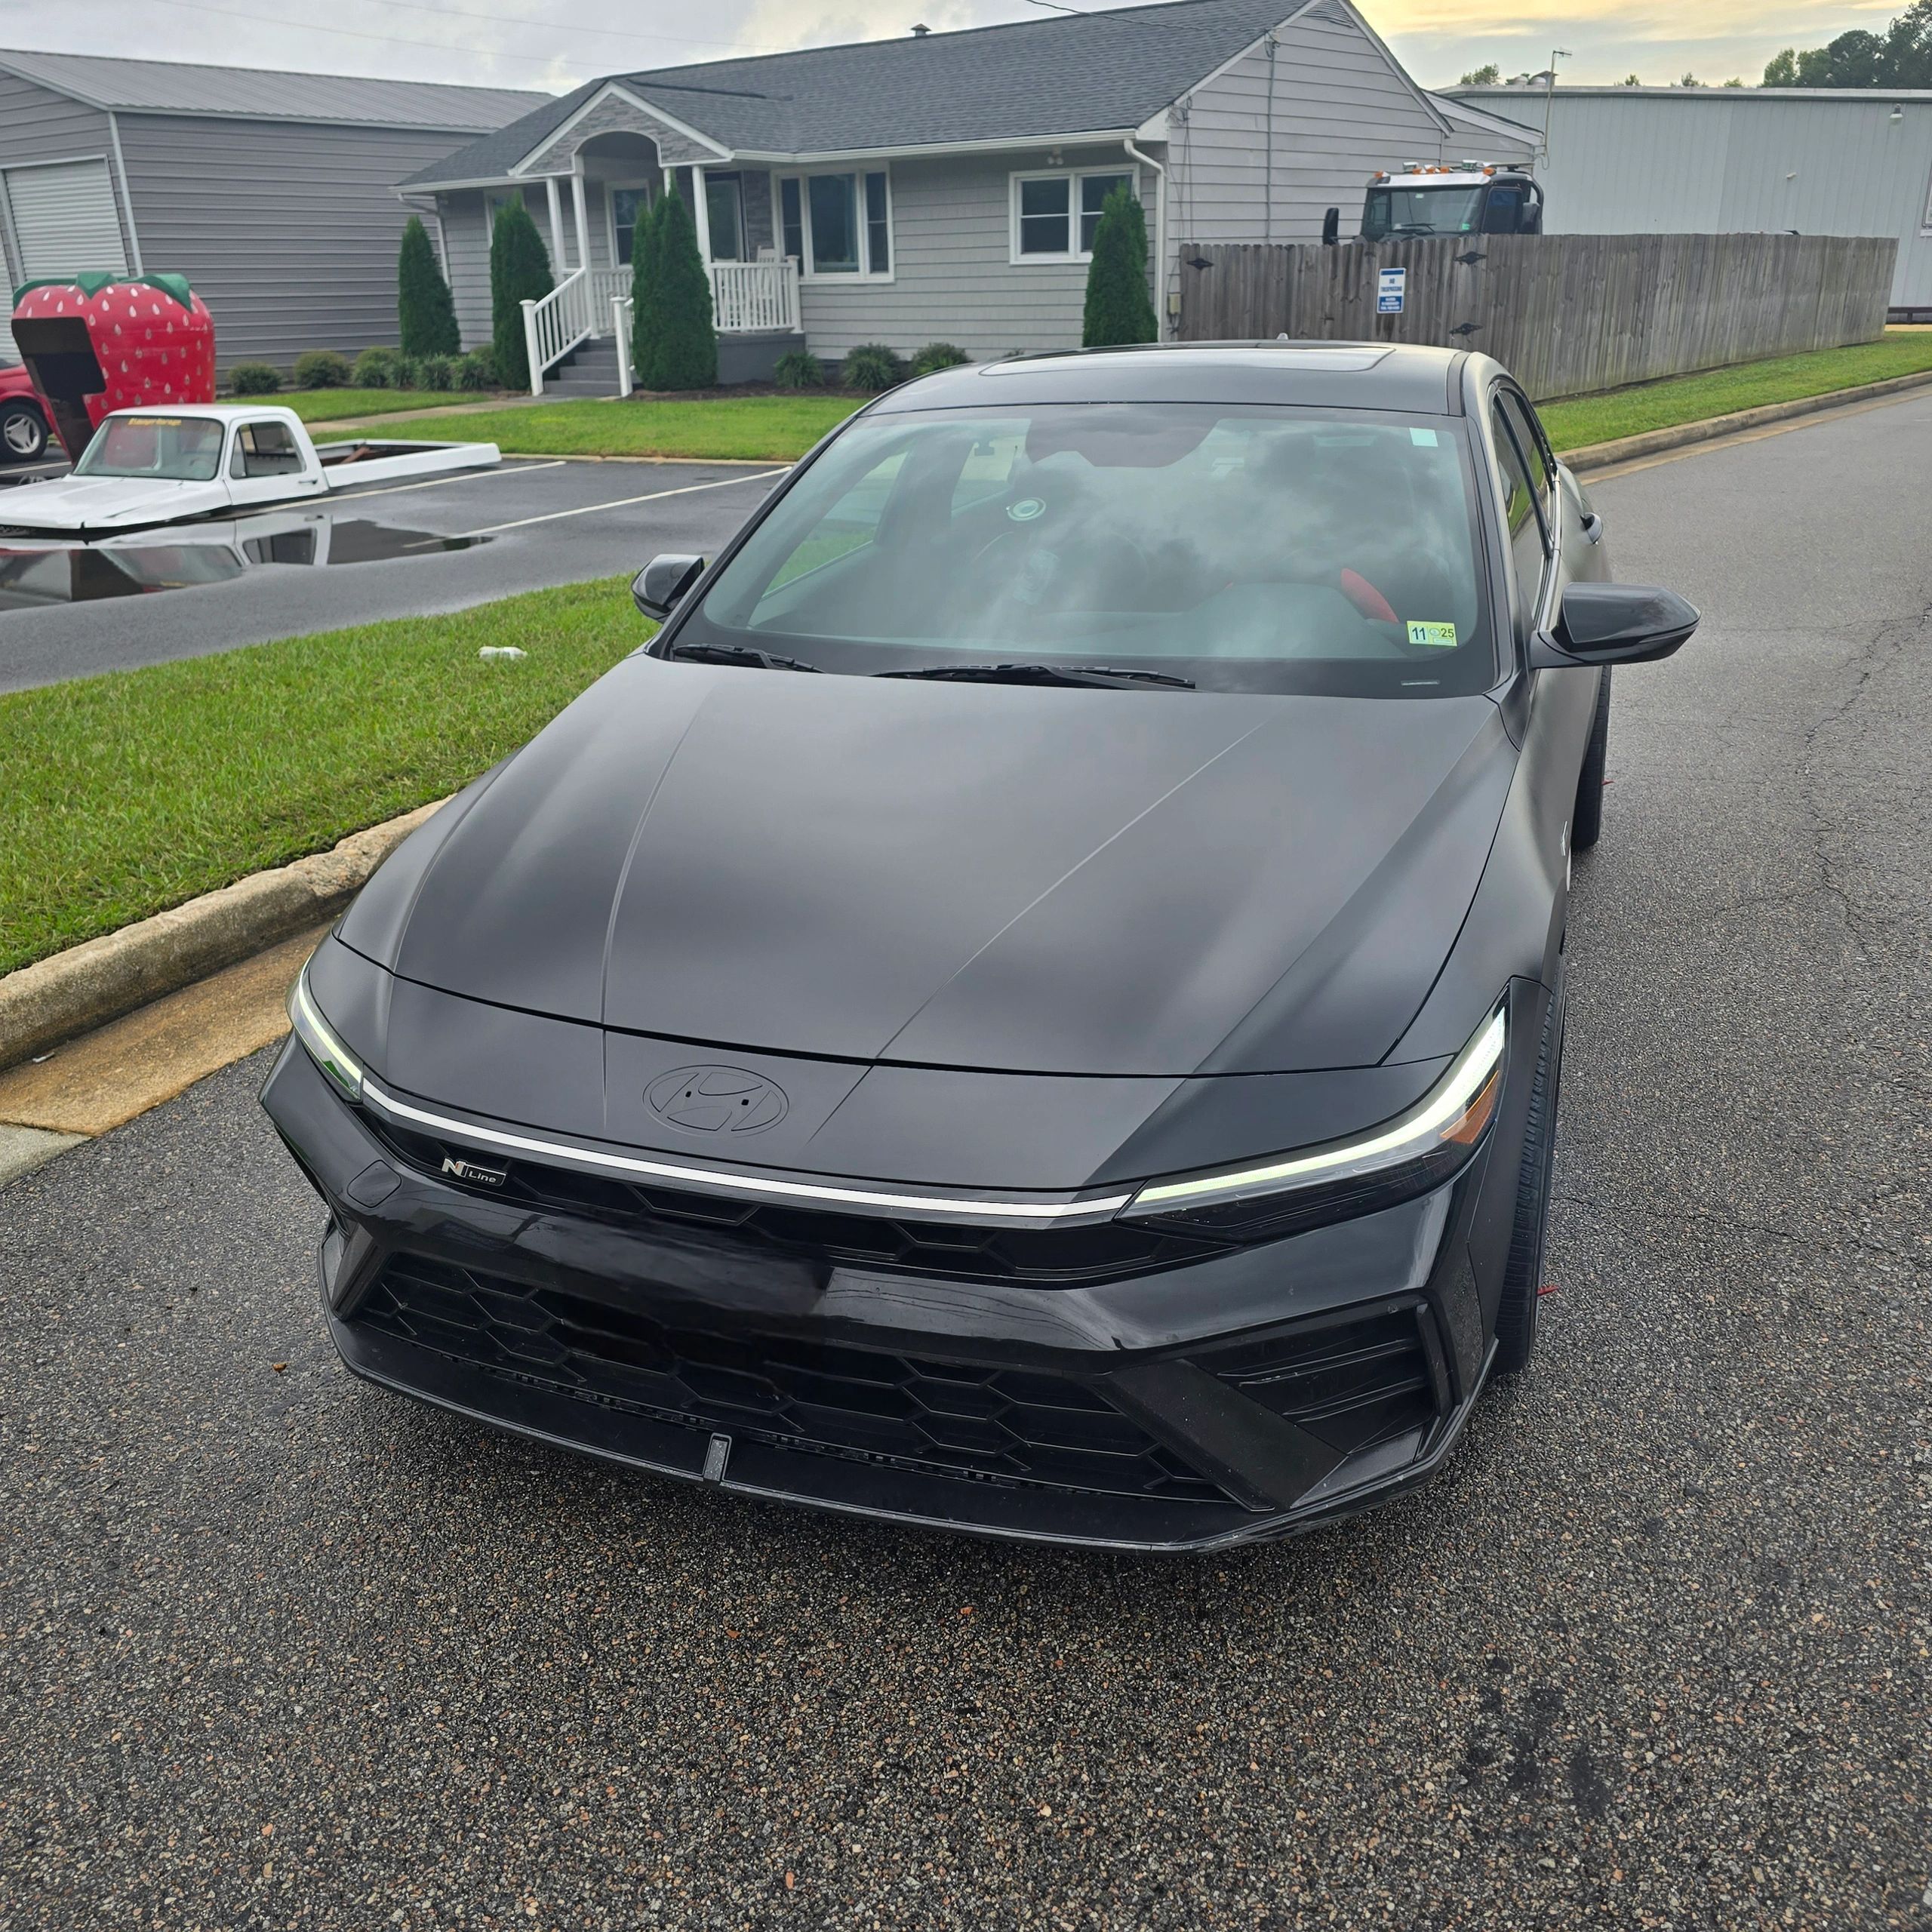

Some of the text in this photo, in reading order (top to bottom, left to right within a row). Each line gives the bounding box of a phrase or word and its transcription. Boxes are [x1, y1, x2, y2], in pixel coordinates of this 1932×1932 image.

[1412, 627, 1454, 640] 11 25
[441, 1158, 497, 1183] N Line
